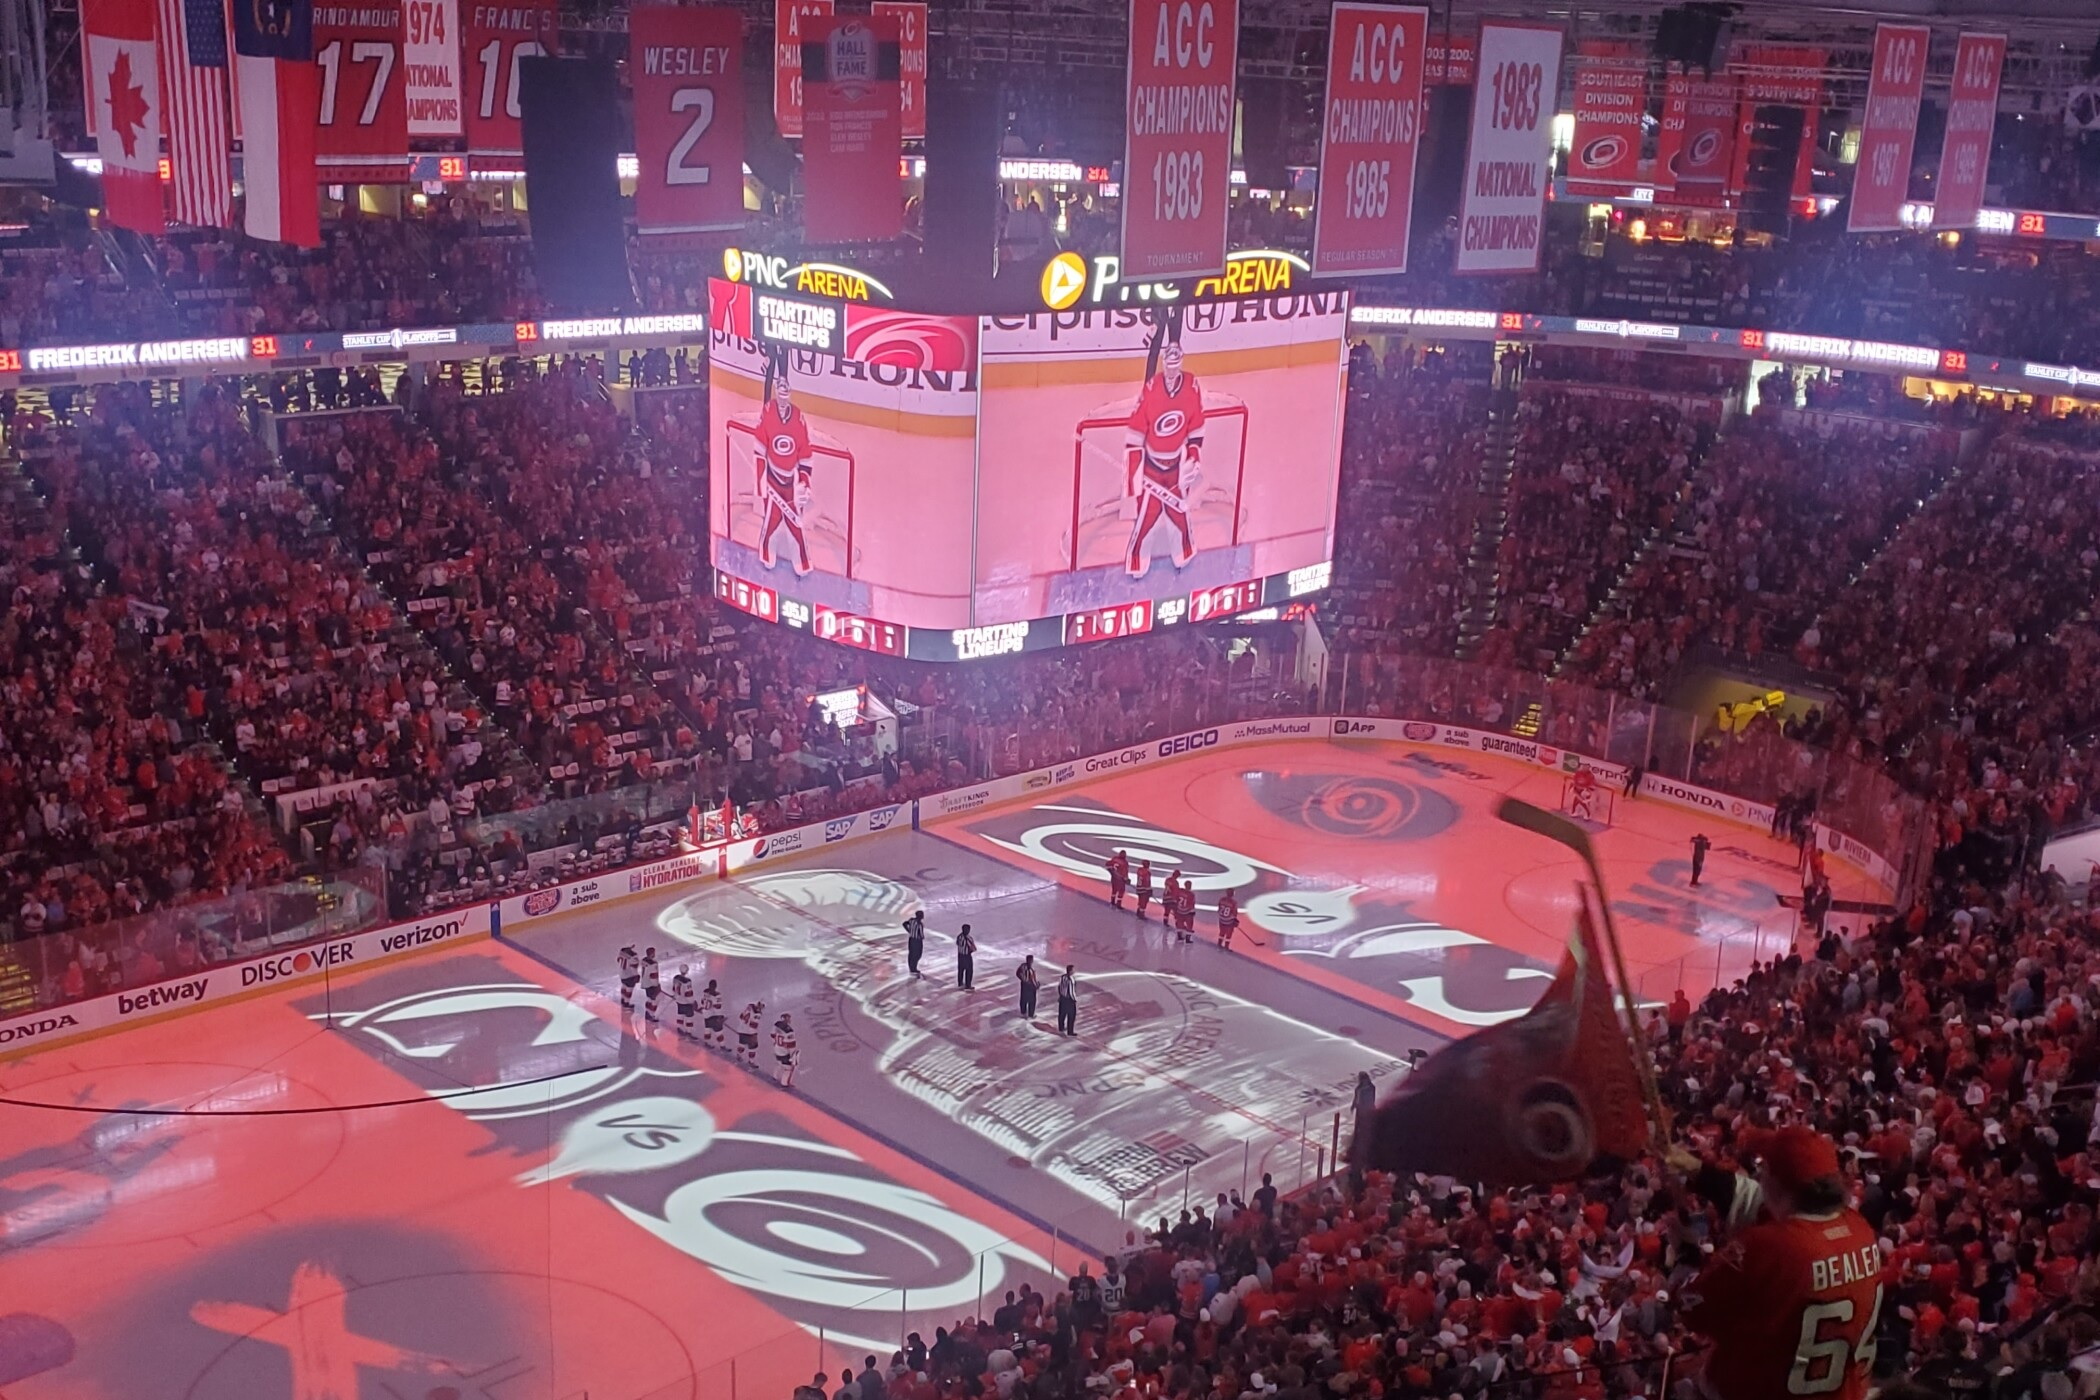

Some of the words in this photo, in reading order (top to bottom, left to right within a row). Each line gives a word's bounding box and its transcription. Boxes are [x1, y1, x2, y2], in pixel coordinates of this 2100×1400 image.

[313, 7, 399, 28] RIND'AMOUR
[474, 6, 551, 30] FRANCS
[1153, 2, 1214, 68] ACC
[837, 40, 867, 56] HALL
[1350, 23, 1406, 85] ACC
[1882, 37, 1916, 84] ACC
[645, 48, 729, 75] WESLEY
[837, 61, 867, 76] FAME
[1963, 44, 1994, 88] ACC
[318, 41, 395, 124] 17
[407, 64, 452, 88] ATIONAL
[1580, 73, 1644, 89] SOUTHEAST
[1492, 61, 1542, 131] 1983
[1585, 93, 1634, 107] DIVISION
[409, 98, 458, 122] AMPIONS
[1134, 84, 1229, 135] CHAMPIONS
[1330, 98, 1416, 145] CHAMPIONS
[1577, 112, 1639, 126] CHAMPIONS
[667, 88, 713, 185] 2
[437, 160, 462, 177] 31
[1000, 161, 1083, 182] ANDERSEN
[1475, 162, 1537, 197] NATIONAL
[1152, 150, 1204, 220] 1983
[1345, 160, 1390, 219] 1985
[1464, 215, 1538, 250] CHAMPIONS
[2020, 215, 2046, 233] 31
[1146, 251, 1204, 266] TOURNAMENT
[1321, 250, 1355, 263] REGULAR
[1357, 250, 1387, 261] SEASON
[742, 251, 788, 289] PNC
[797, 264, 869, 301] ARENA
[759, 296, 837, 331] STARTING
[1351, 307, 1412, 326] EDERIK
[1413, 309, 1497, 330] ANDERSEN
[1501, 313, 1523, 330] 31
[516, 323, 538, 340] 31
[543, 317, 623, 339] FREDERIK
[624, 314, 704, 335] ANDERSEN
[764, 317, 830, 349] LINEUPS
[30, 345, 138, 369] FREDERIK
[139, 337, 247, 364] ANDERSEN
[252, 336, 277, 356] 31
[343, 335, 375, 346] STANLEY
[375, 334, 391, 345] CUP
[1742, 331, 1763, 348] 31
[1767, 332, 1851, 357] FREDERIK
[1851, 339, 1940, 368] ANDERSEN
[1945, 351, 1967, 369] 31
[823, 610, 836, 635] 0
[1132, 606, 1144, 630] 0
[953, 620, 1029, 645] STARTING
[958, 635, 1023, 660] LINEUPS
[1246, 723, 1311, 737] MassMutual
[1444, 737, 1470, 747] above
[1454, 730, 1469, 739] sub
[1159, 730, 1218, 758] GEICO
[1482, 736, 1538, 758] guaranteed
[1086, 757, 1119, 773] Great
[1120, 750, 1147, 765] Clips
[947, 800, 984, 812] SPORTSBOOK
[1660, 784, 1726, 810] HONDA
[827, 820, 851, 840] SAP
[870, 810, 895, 829] SAP
[771, 830, 801, 850] pepsi
[571, 893, 600, 906] above
[572, 886, 578, 895] a
[582, 882, 598, 893] sub
[380, 921, 460, 953] verizon
[241, 941, 354, 987] DISCOVER
[117, 976, 209, 1015] betway
[0, 1014, 79, 1043] ONDA
[596, 1113, 693, 1151] VS
[1787, 1281, 1884, 1395] 64
